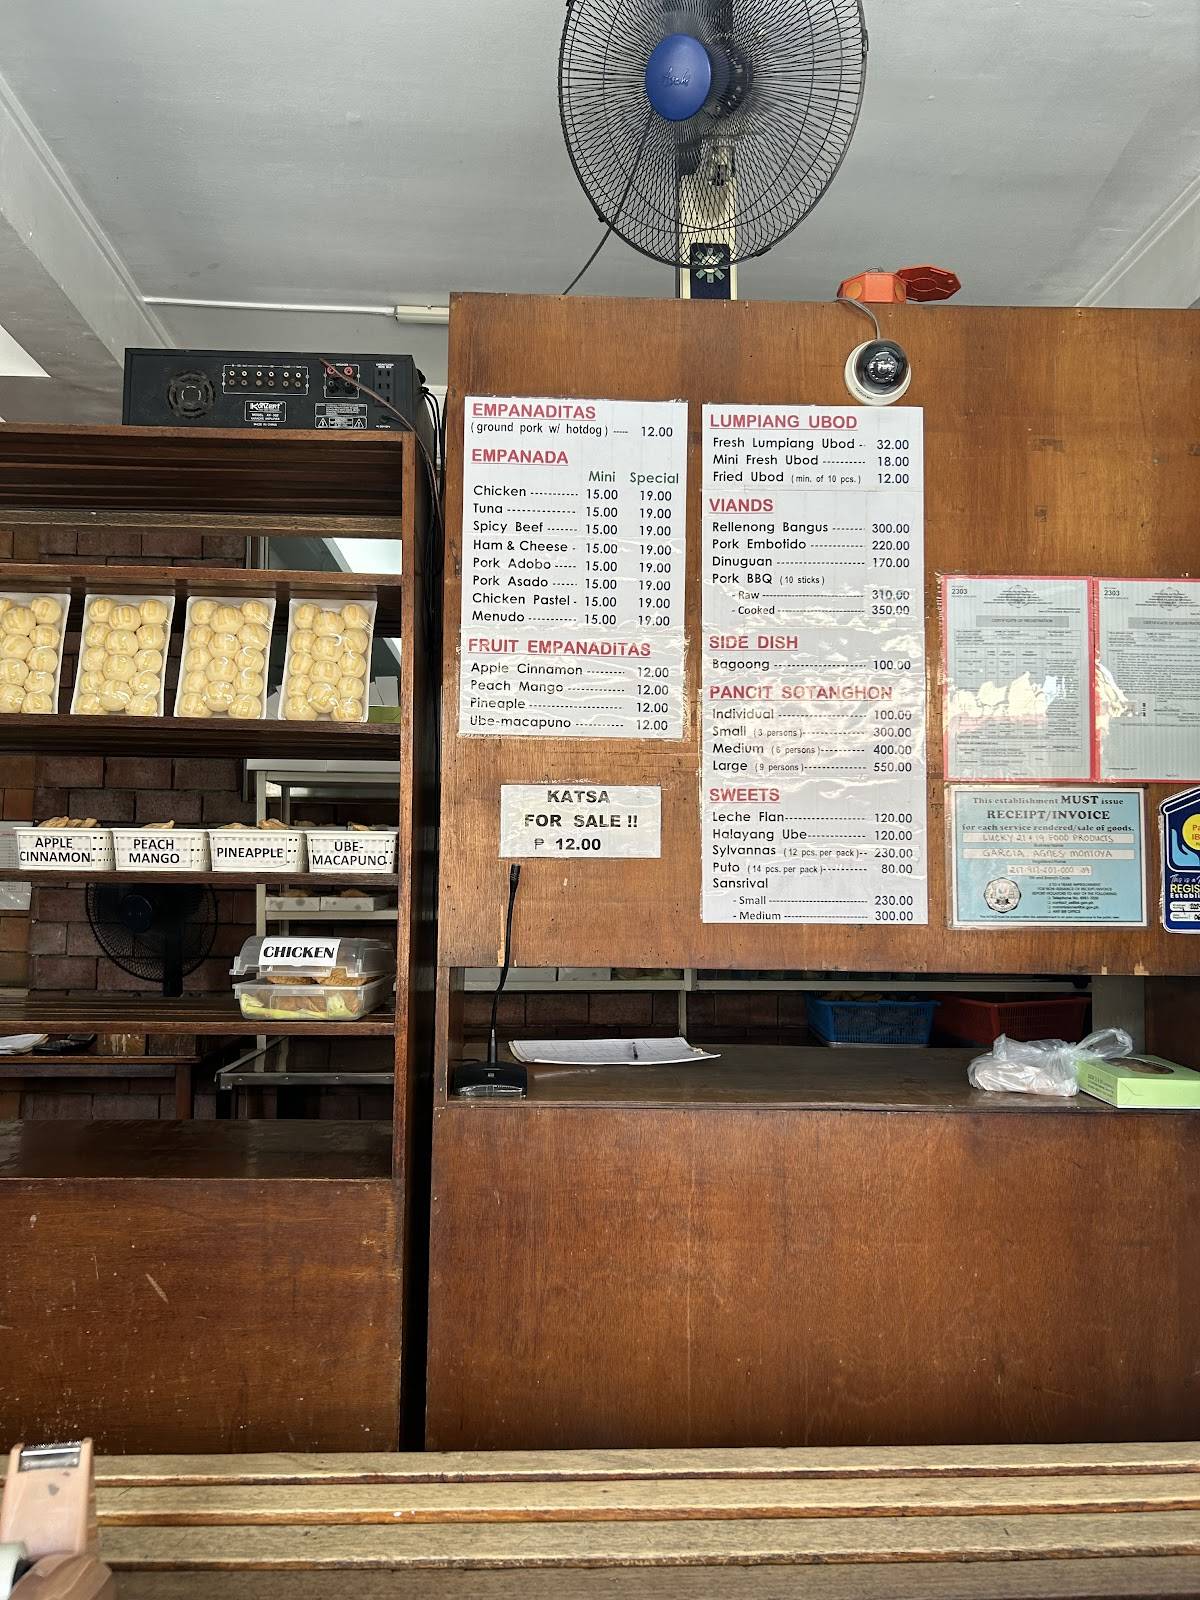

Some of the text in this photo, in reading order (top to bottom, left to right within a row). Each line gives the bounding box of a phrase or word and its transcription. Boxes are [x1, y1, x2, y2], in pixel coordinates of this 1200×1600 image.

[473, 403, 596, 419] EMPANADITAS
[711, 414, 857, 428] LUMPIANG UBOD
[520, 424, 543, 433] pork
[549, 424, 560, 433] w/
[641, 427, 673, 437] 12.00
[713, 438, 909, 450] Fresh Lumpiang Ubod 32.00
[472, 449, 568, 464] EMPANADA
[713, 455, 909, 466] Mini Fresh Ubod 18.00
[589, 471, 679, 484] Mini Special
[713, 472, 743, 481] Fried
[751, 472, 783, 482] Ubod
[816, 475, 824, 483] of
[878, 474, 909, 484] 12.00
[474, 486, 672, 501] Chicken 15.00 19.00
[473, 504, 671, 519] Tuna 15.00 19.00
[709, 499, 774, 512] VIANDS
[473, 521, 671, 536] Spicy Beef 15.00 19.00
[713, 522, 909, 535] Rellenong Bangus 300.00
[473, 540, 671, 555] Ham Cheese 15.00 19.00
[713, 539, 739, 549] Pork
[872, 541, 910, 551] 220.00
[473, 558, 671, 573] Pork Adobo 15.00 19.00
[713, 557, 910, 569] Dinuguan 170.00
[473, 576, 670, 591] Pork Asado 15.00 19.00
[713, 574, 739, 584] Pork
[747, 574, 772, 584] BBQ
[473, 593, 670, 608] Chicken Pastel 15.00 19.00
[739, 590, 910, 600] Raw 310.00
[738, 606, 909, 615] Cooked 350.00
[472, 611, 670, 626] Menudo 15.00 19.00
[468, 639, 651, 656] FRUIT EMPANADITAS
[710, 636, 798, 649] SIDE DISH
[471, 663, 669, 677] Apple Cinnamon 12.00
[713, 660, 911, 671] Bagoong 100.00
[471, 680, 668, 695] Peach Mango 12.00
[709, 686, 892, 699] PANCIT SOTANGHON
[471, 698, 668, 713] Pineaple 12.00
[713, 709, 911, 720] Individual 100.00
[471, 716, 667, 730] Ube-macapuno 12.00
[713, 727, 911, 737] Small 300.00
[713, 744, 763, 754] Medium
[873, 745, 911, 755] 400.00
[713, 761, 747, 771] Large
[873, 763, 911, 772] 550.00
[548, 791, 610, 802] KATSA
[710, 788, 780, 802] SWEETS
[1061, 795, 1098, 805] MUST
[525, 815, 620, 827] FOR SALE
[713, 812, 912, 823] Leche Flan 120.00
[987, 810, 1110, 821] RECEIPT/INVOICE
[713, 829, 912, 841] Halayang Ube 120.00
[983, 834, 1013, 842] LUCKY
[35, 837, 73, 849] APPLE
[133, 838, 174, 851] PEACH
[334, 841, 364, 852] UBE-
[556, 838, 601, 850] 12.00
[20, 852, 90, 863] CINNAMON
[217, 847, 283, 859] PINEAPPLE
[713, 845, 776, 857] Sylvannas
[875, 849, 912, 858] 230.00
[129, 852, 180, 864] MANGO
[312, 854, 386, 866] MACAPUNO
[713, 863, 740, 873] Puto
[784, 866, 795, 874] per
[882, 864, 912, 873] 80.00
[713, 878, 768, 888] Sansrival
[739, 896, 913, 905] Small 230.00
[739, 911, 913, 921] Medium 300.00
[264, 945, 335, 959] CHICKEN
